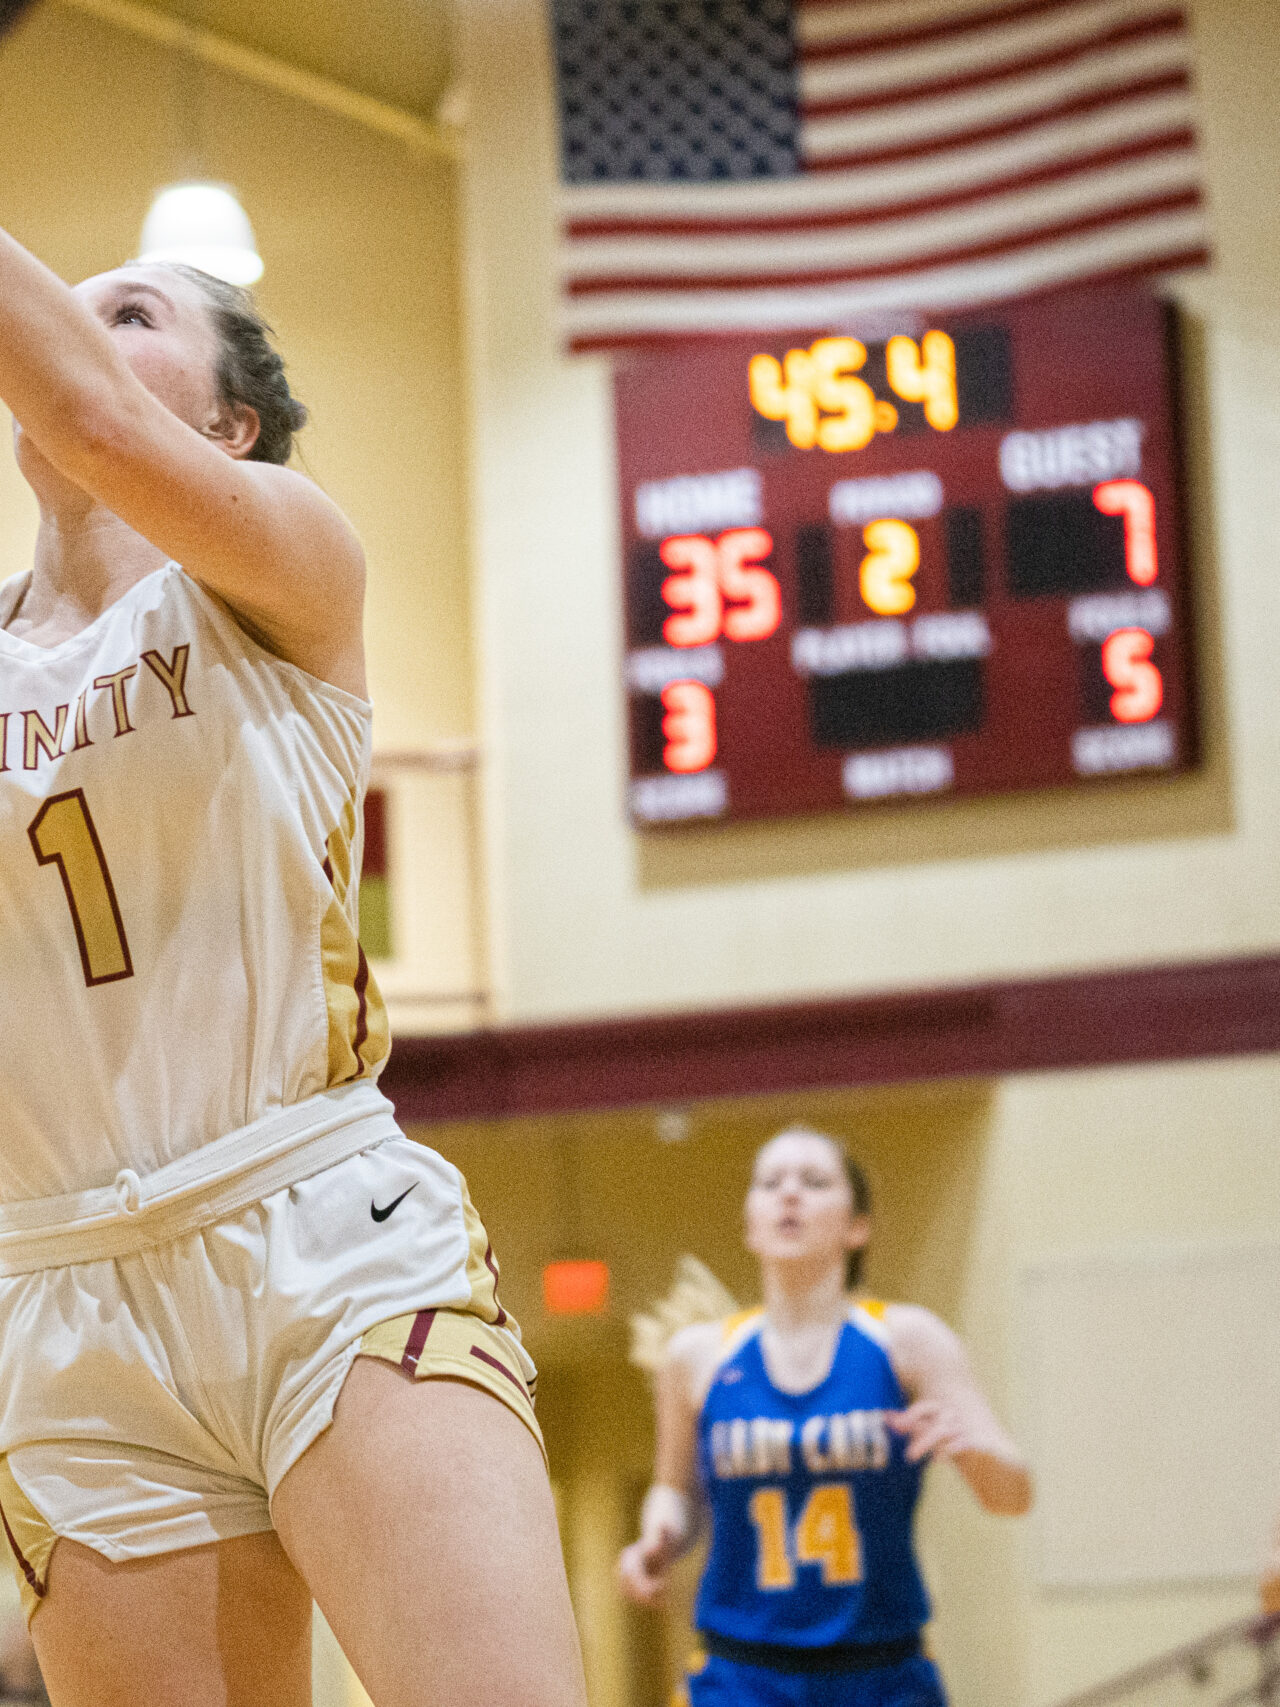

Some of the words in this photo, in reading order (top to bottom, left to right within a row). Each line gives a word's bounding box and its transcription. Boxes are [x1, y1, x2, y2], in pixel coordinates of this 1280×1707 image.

[749, 329, 959, 453] 45.4
[1000, 418, 1144, 492] GUEST
[859, 518, 921, 616] 2
[1093, 477, 1158, 586] 7
[660, 526, 783, 648] 35
[661, 679, 717, 774] 3
[1102, 627, 1163, 724] 5
[27, 788, 135, 988] 1
[749, 1484, 863, 1591] 14
